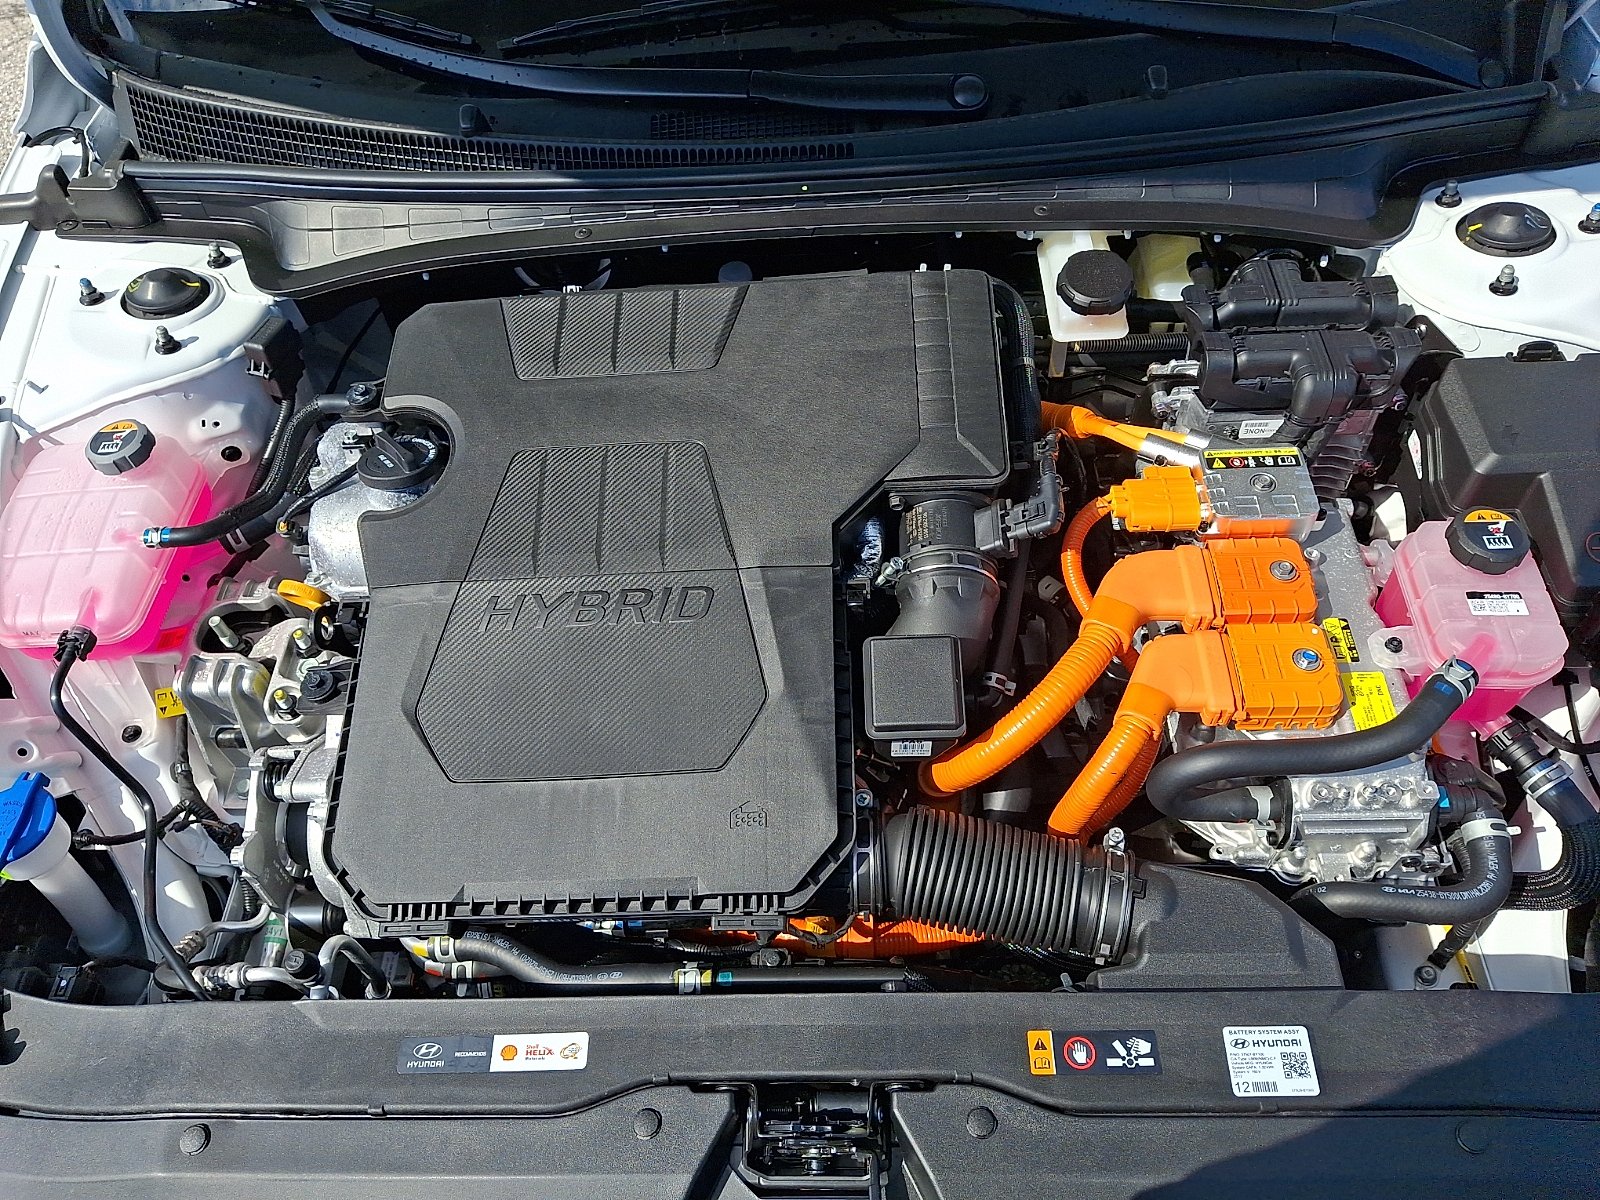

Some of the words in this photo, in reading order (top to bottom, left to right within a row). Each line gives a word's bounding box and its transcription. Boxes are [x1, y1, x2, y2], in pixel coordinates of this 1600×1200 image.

[478, 585, 715, 632] HYBRID
[1252, 1039, 1302, 1047] HYUNDAI
[525, 1048, 554, 1056] HELIX
[1235, 1081, 1251, 1093] 12
